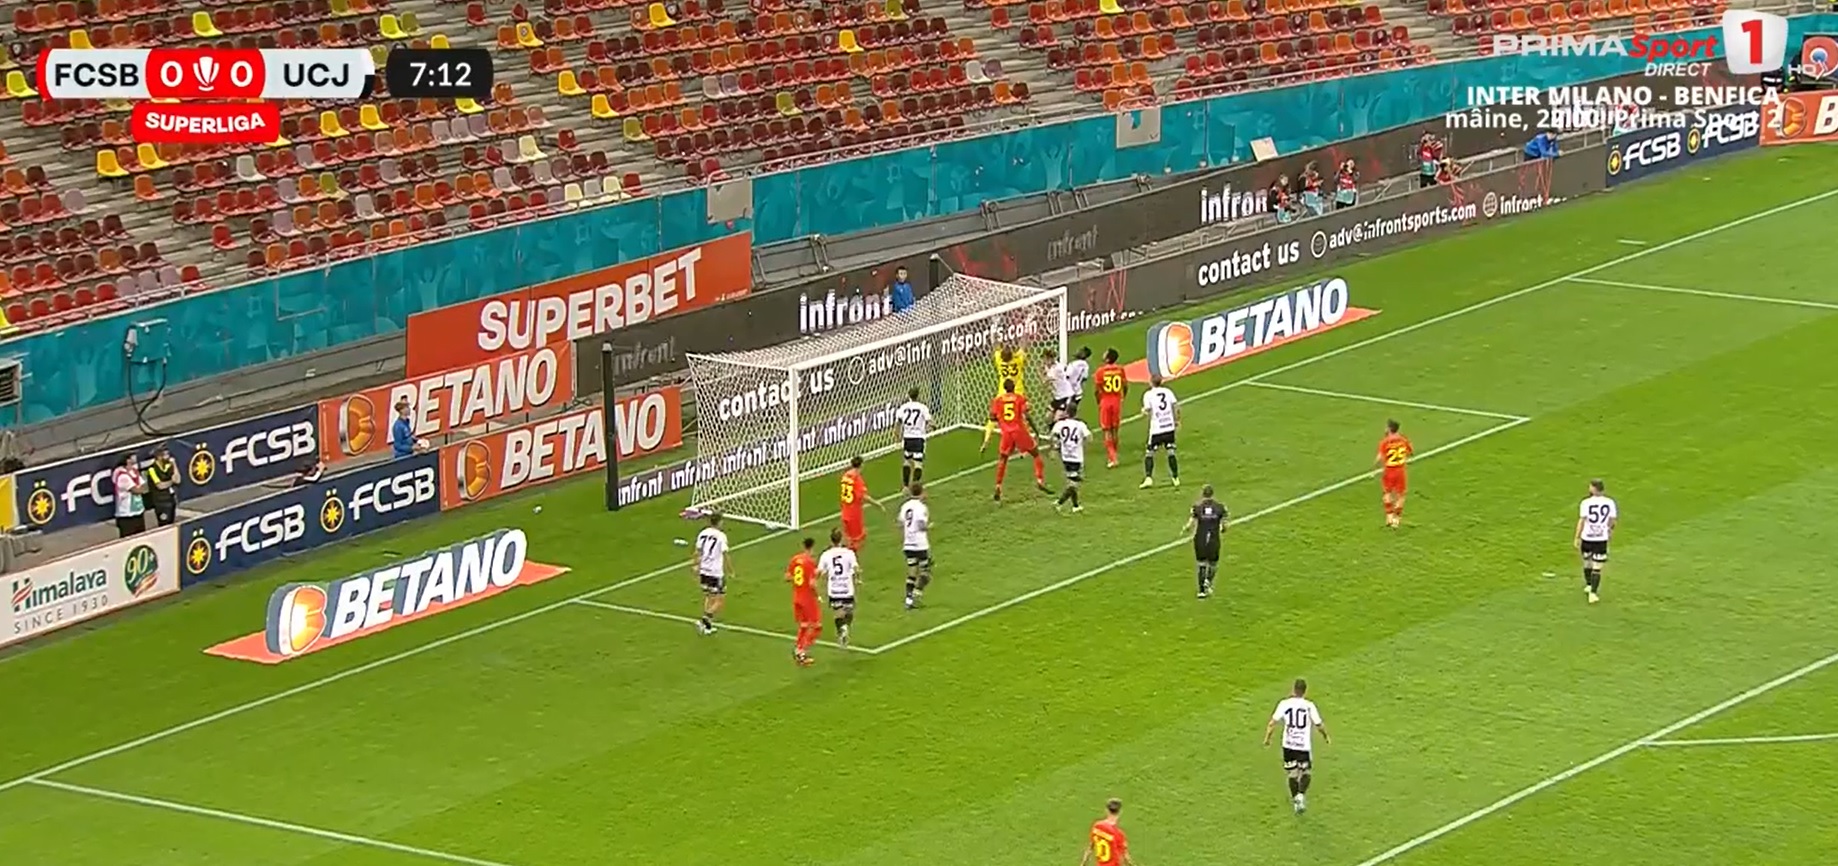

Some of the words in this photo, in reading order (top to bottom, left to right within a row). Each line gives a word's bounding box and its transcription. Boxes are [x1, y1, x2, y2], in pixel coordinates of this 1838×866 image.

[1622, 131, 1682, 170] FCSB
[1201, 182, 1267, 225] infron
[1329, 202, 1477, 250] adv@infrontsports.com
[1198, 247, 1271, 286] contact
[1278, 239, 1300, 266] us
[478, 246, 702, 350] SUPERBET
[800, 285, 892, 334] infront
[1198, 278, 1348, 365] BETANO
[386, 348, 558, 443] BETANO
[719, 374, 800, 421] contac
[810, 367, 835, 394] us
[1103, 375, 1122, 393] 30
[1157, 393, 1167, 410] 3
[903, 408, 921, 426] 27
[1003, 403, 1015, 421] 5
[220, 420, 317, 474] FCSB
[501, 393, 666, 488] BETANO
[1061, 426, 1079, 445] 94
[1386, 447, 1407, 466] 25
[215, 503, 305, 561] FCSB
[348, 466, 435, 521] FCSB
[905, 508, 914, 528] 9
[1588, 504, 1611, 524] 59
[700, 534, 718, 554] 77
[330, 529, 528, 639] BETANO
[793, 565, 804, 586] 8
[832, 555, 844, 576] 5
[12, 569, 107, 613] Himalaya
[14, 608, 64, 634] SINCE
[73, 595, 109, 614] 1930
[1284, 707, 1307, 729] 10
